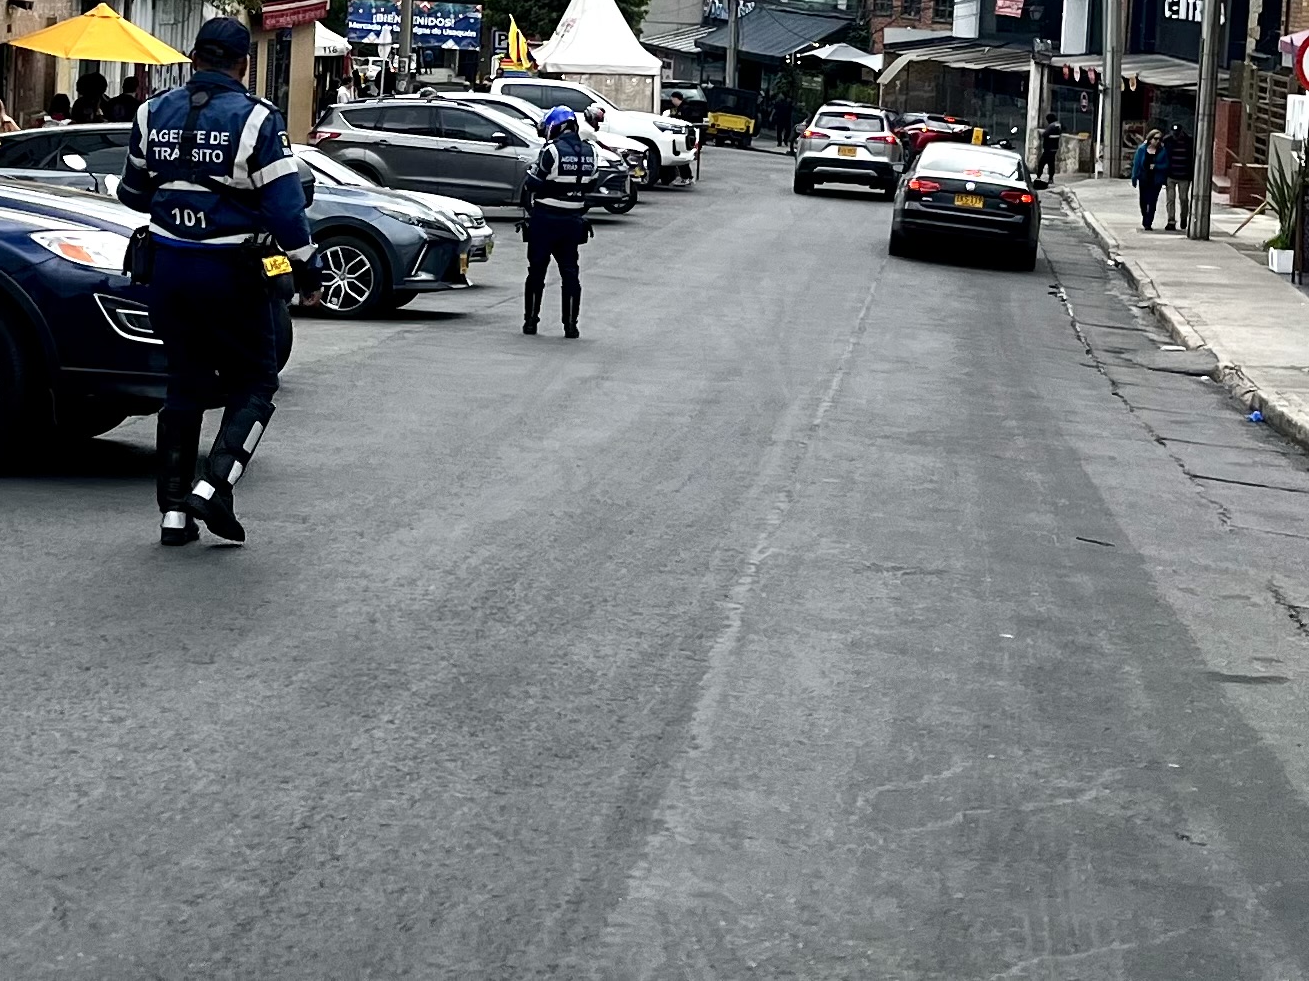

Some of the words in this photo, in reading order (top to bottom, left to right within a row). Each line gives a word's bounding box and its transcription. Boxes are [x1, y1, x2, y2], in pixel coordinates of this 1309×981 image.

[372, 13, 455, 28] ¡BIENENIDOS!
[148, 129, 206, 144] AGEE
[209, 132, 230, 145] DE
[153, 145, 224, 163] TRÁSITO
[171, 207, 207, 229] 101
